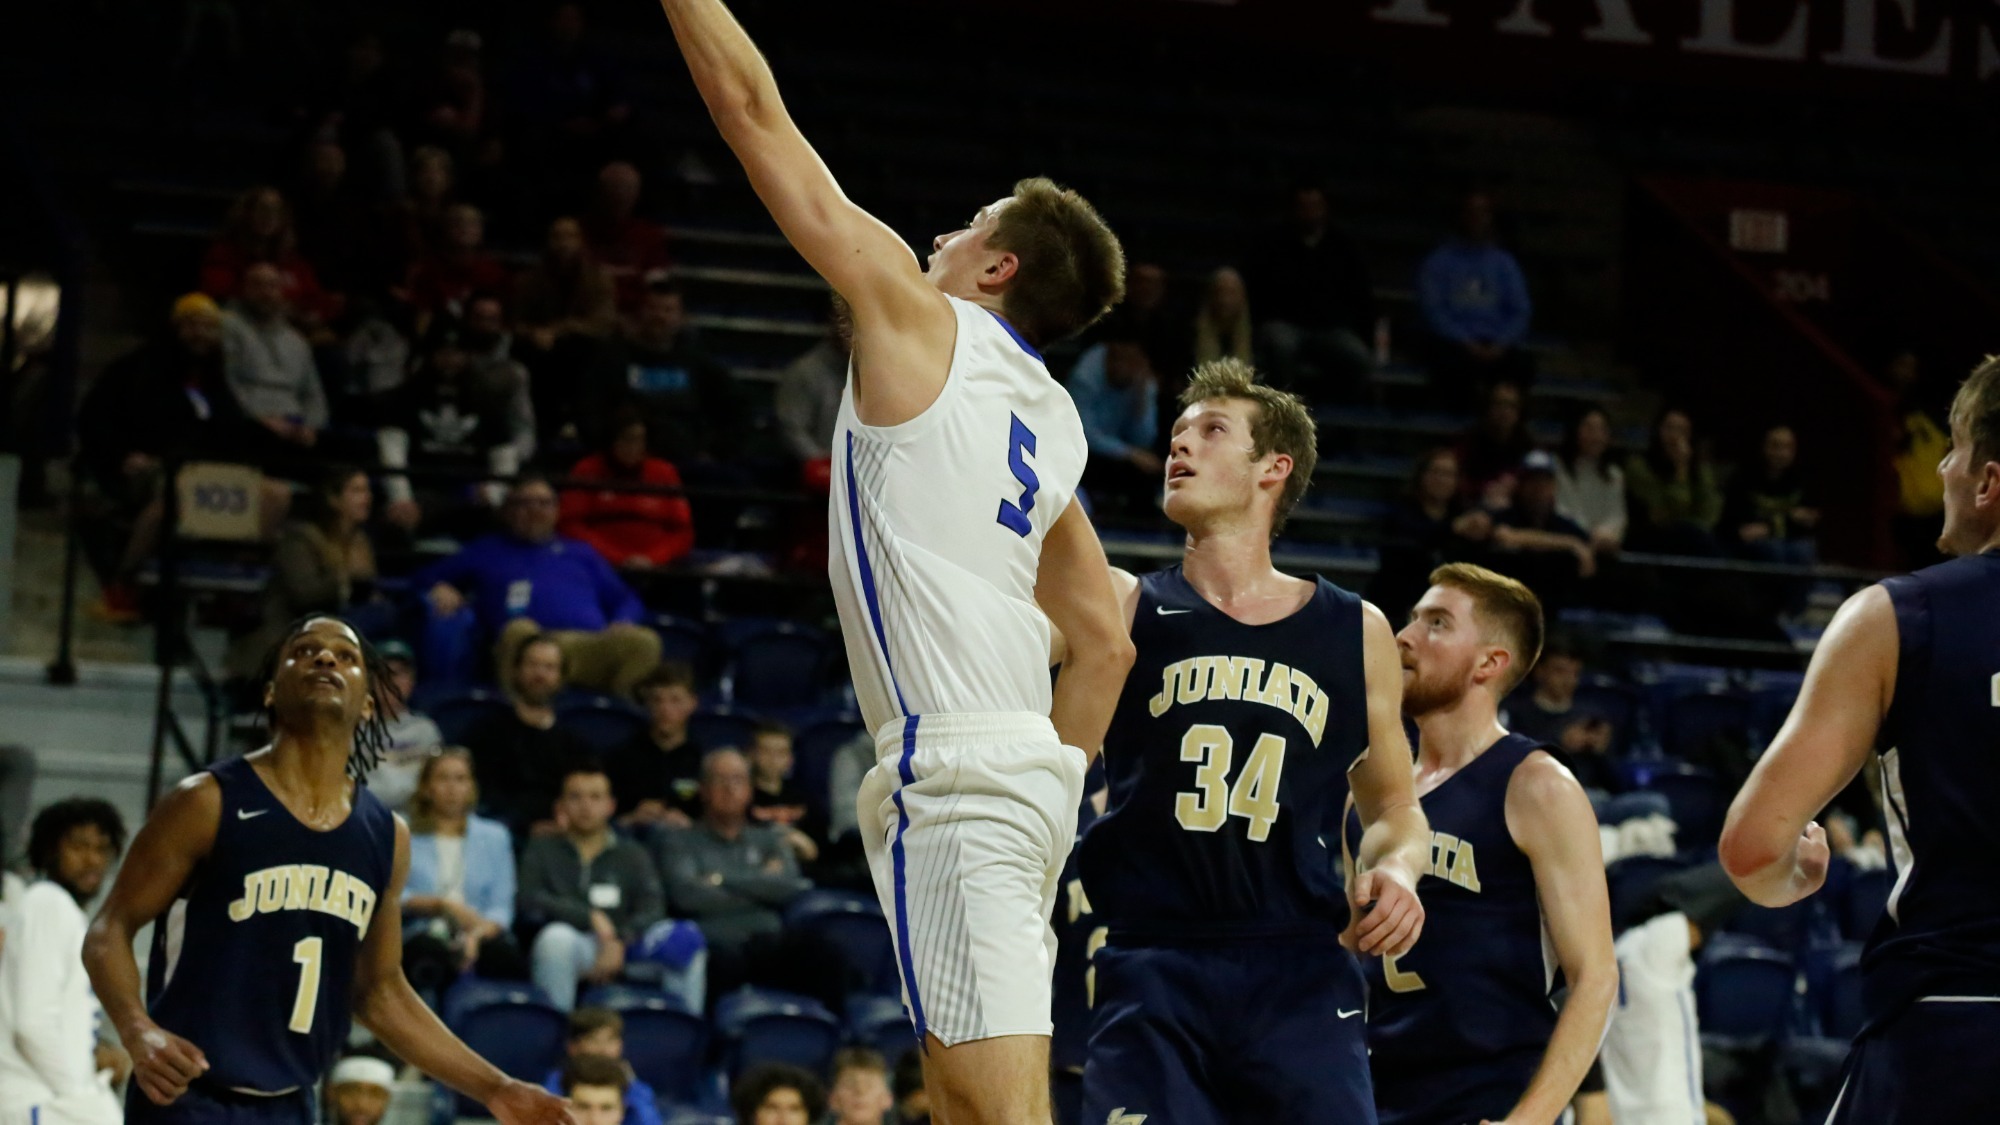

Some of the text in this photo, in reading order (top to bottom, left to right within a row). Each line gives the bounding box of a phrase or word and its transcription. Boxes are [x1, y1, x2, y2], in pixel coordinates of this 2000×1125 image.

[195, 484, 248, 515] 103
[997, 410, 1041, 538] 5
[1149, 655, 1329, 749] JUNIATA
[1174, 723, 1280, 842] 34
[288, 936, 323, 1034] 1
